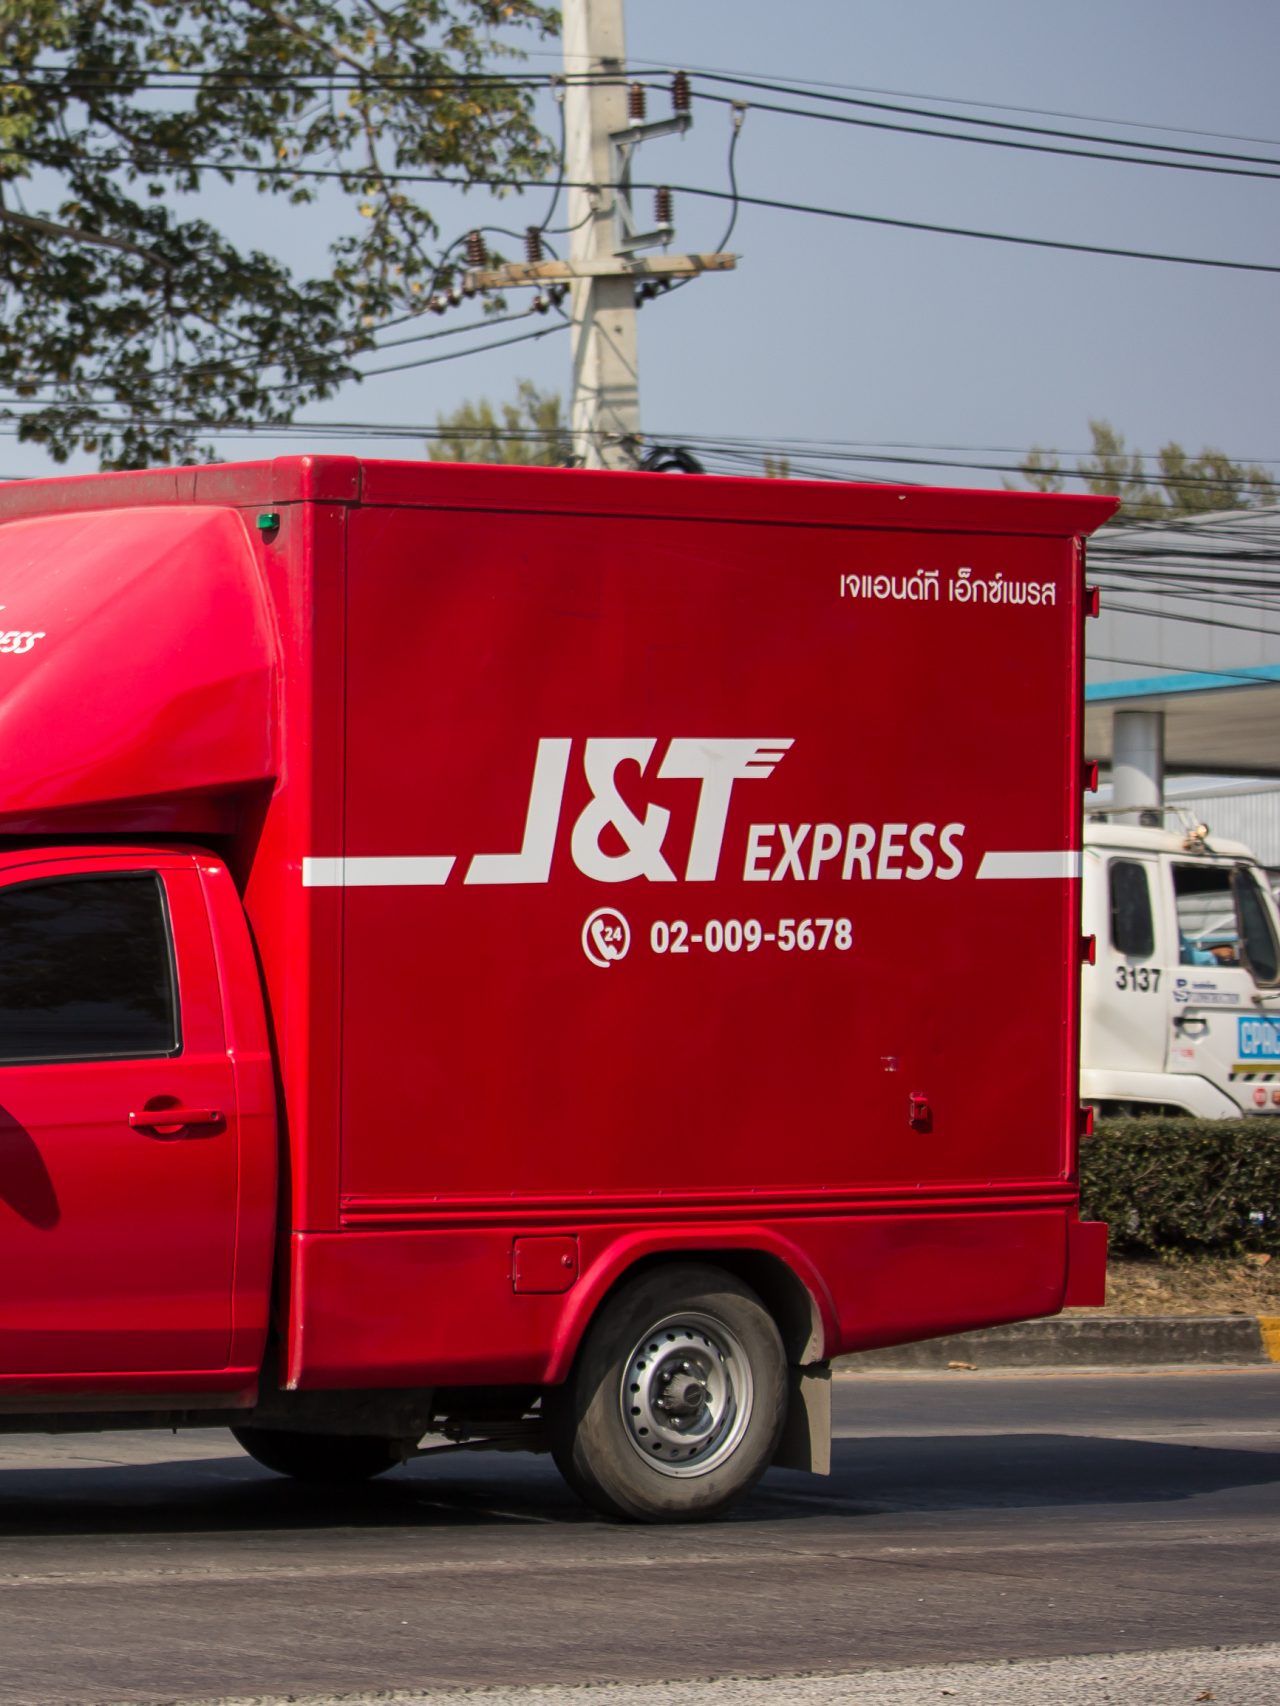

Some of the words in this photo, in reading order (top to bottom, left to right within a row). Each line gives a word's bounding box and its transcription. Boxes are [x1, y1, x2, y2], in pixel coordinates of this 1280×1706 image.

[839, 569, 940, 601] เจแอนด์ที
[948, 567, 1057, 606] เอ็กซ์เพรส
[463, 737, 796, 885] J&T
[742, 822, 966, 882] EXPRESS
[604, 926, 623, 942] 24
[650, 918, 853, 954] 02-009-5678
[1115, 966, 1162, 993] 3137
